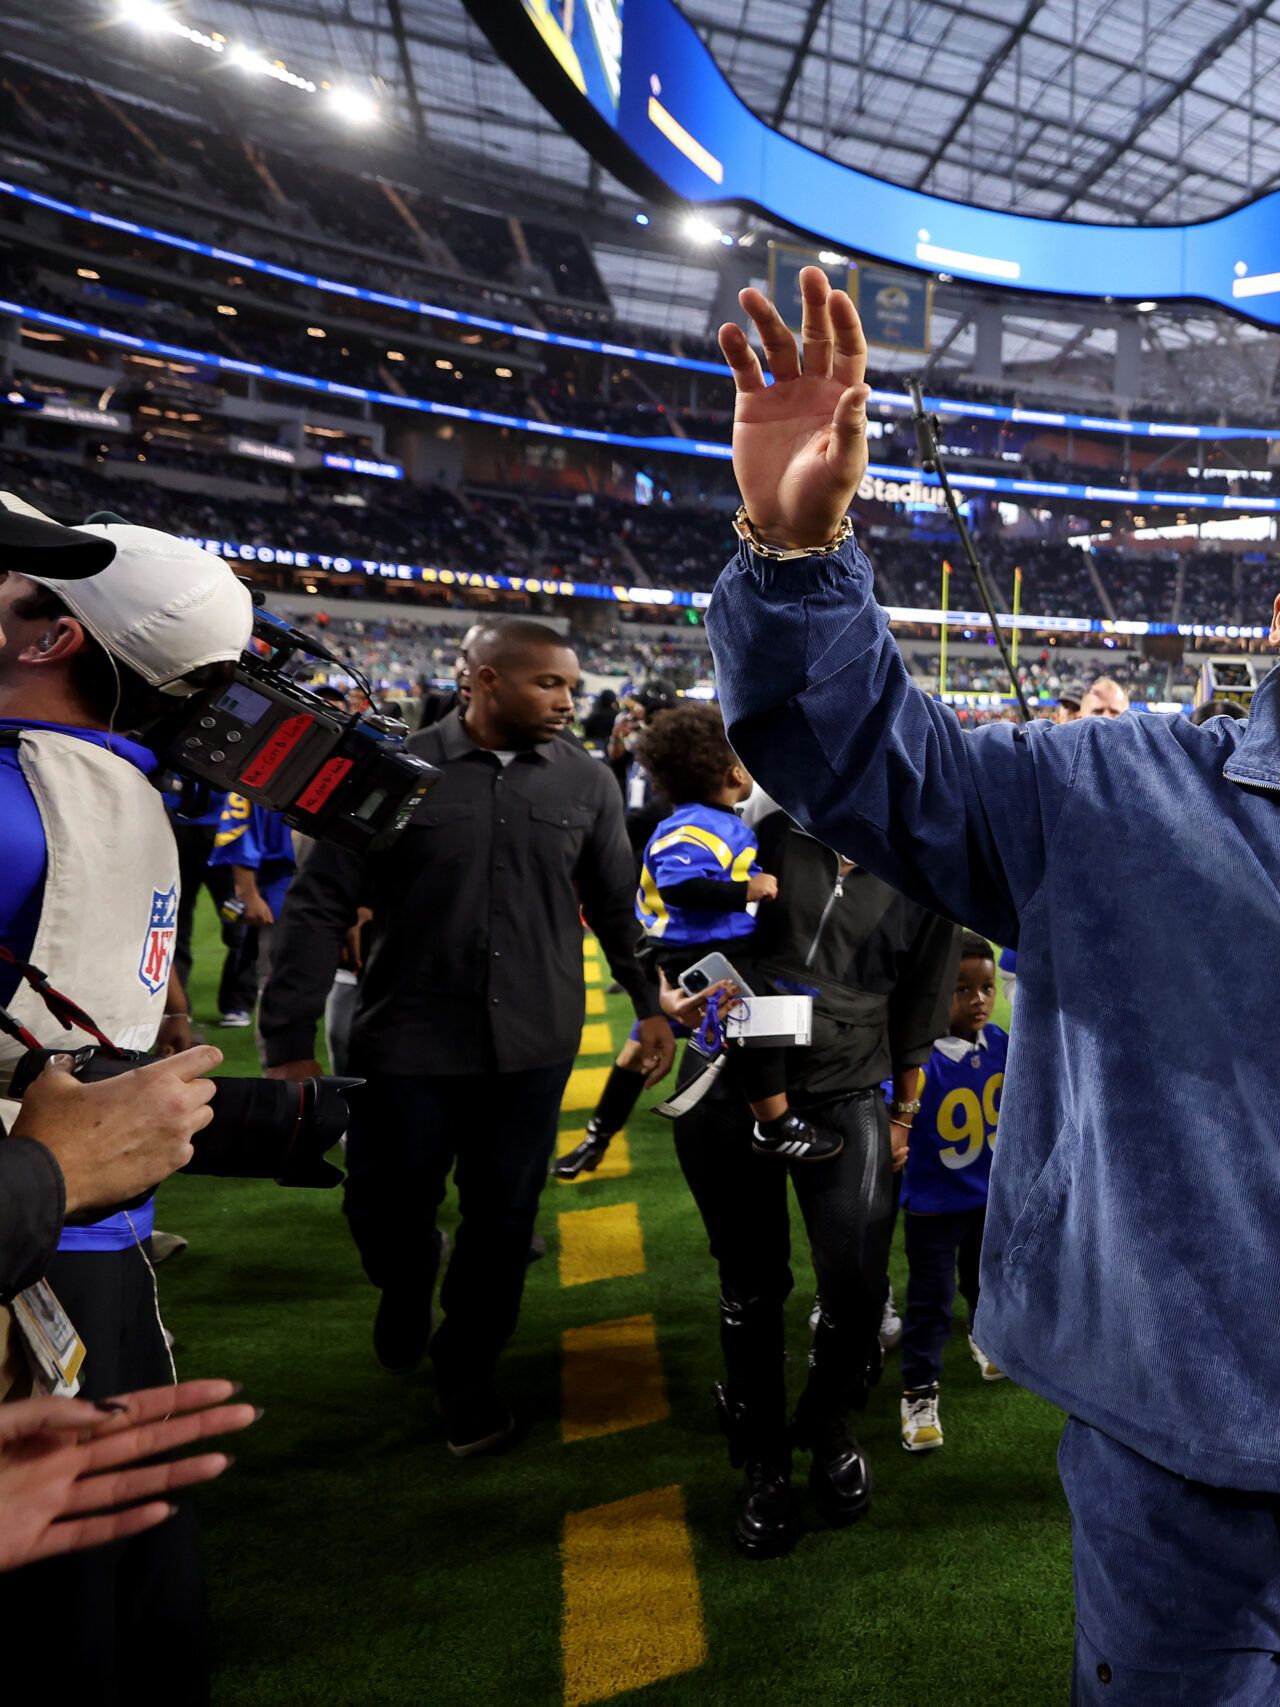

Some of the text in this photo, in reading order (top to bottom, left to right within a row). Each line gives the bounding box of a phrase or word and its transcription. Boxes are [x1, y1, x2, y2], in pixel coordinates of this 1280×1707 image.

[857, 474, 963, 507] Stadium
[318, 555, 352, 573] TO
[362, 560, 413, 580] THE
[421, 567, 500, 590] ROYAL
[508, 576, 576, 597] TOUR
[1177, 623, 1264, 638] WELCOME
[145, 931, 174, 983] NF
[936, 1072, 1005, 1170] 99
